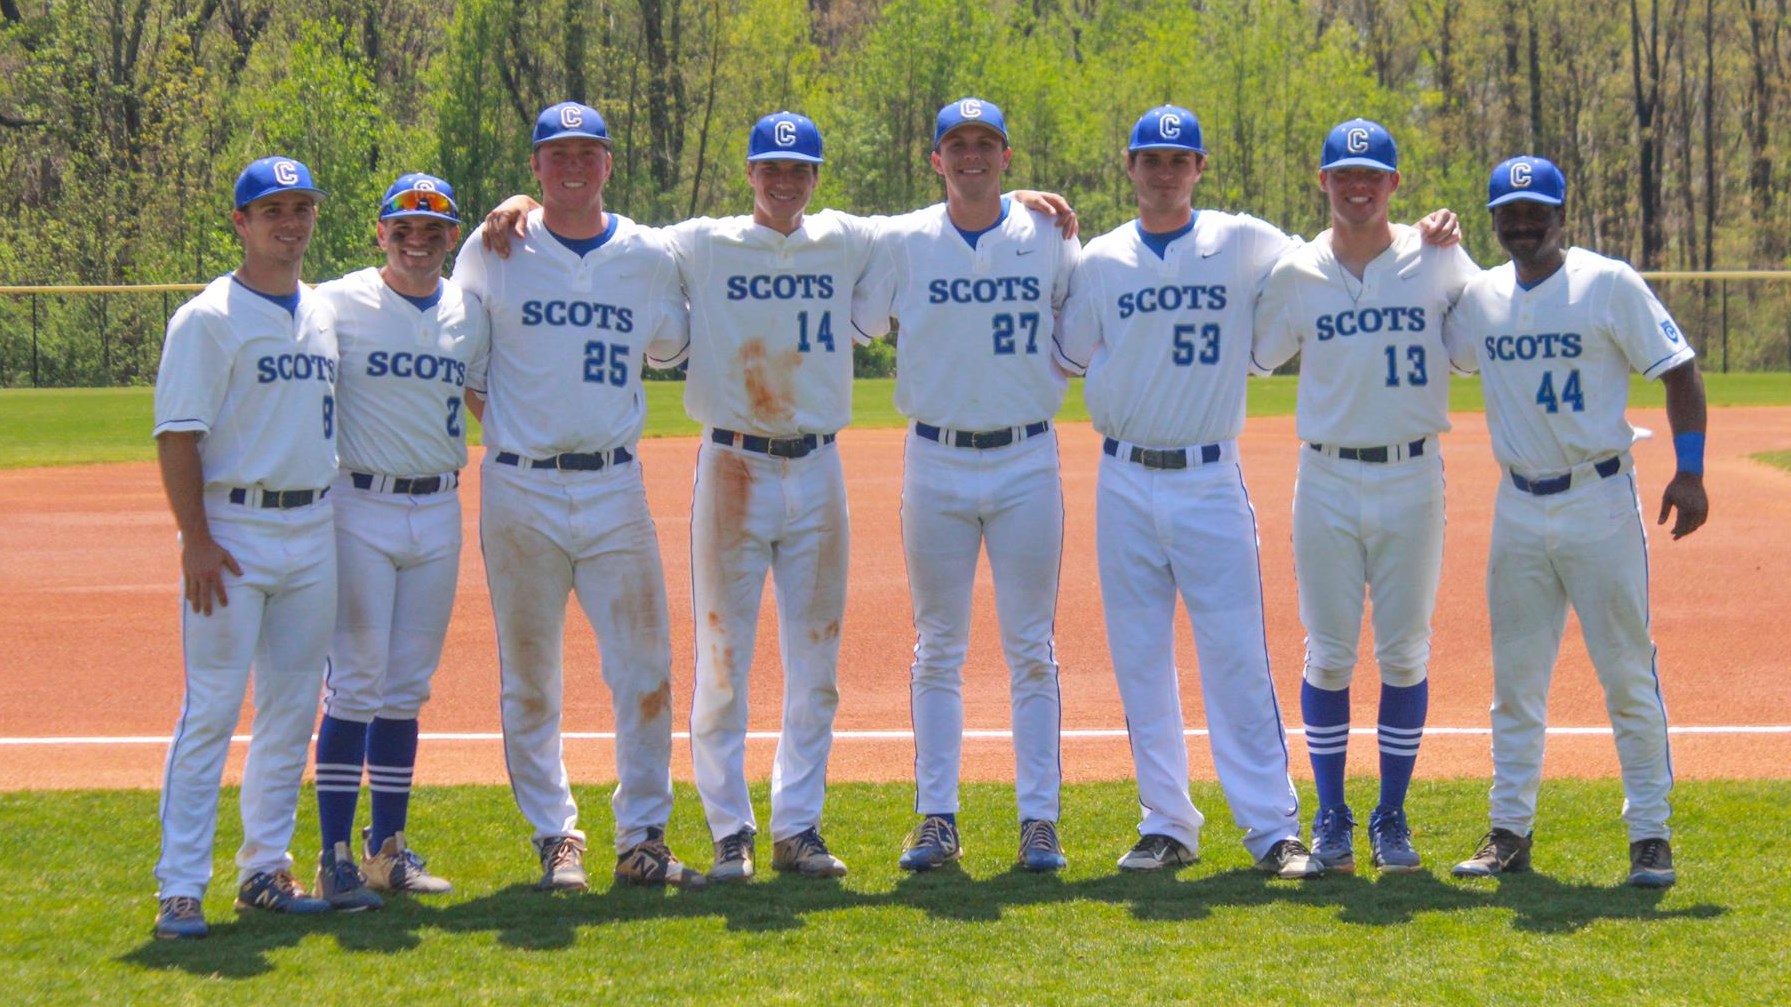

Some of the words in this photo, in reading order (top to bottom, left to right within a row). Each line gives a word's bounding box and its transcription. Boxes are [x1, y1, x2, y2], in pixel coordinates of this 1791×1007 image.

[561, 106, 582, 128] C
[960, 100, 982, 118] C
[774, 121, 796, 146] C
[1160, 114, 1180, 139] C
[1347, 128, 1368, 153] C
[273, 161, 298, 185] C
[1510, 163, 1532, 187] C
[727, 274, 834, 300] SCOTS
[929, 277, 1040, 303] SCOTS
[1118, 285, 1226, 318] SCOTS
[522, 301, 633, 332] SCOTS
[797, 311, 835, 352] 14
[1316, 307, 1425, 340] SCOTS
[992, 312, 1040, 355] 27
[1173, 323, 1220, 366] 53
[1485, 333, 1583, 361] SCOTS
[257, 353, 335, 384] SCOTS
[367, 351, 465, 387] SCOTS
[583, 340, 630, 387] 25
[1384, 345, 1428, 387] 13
[1536, 369, 1585, 414] 44
[446, 396, 461, 437] 2
